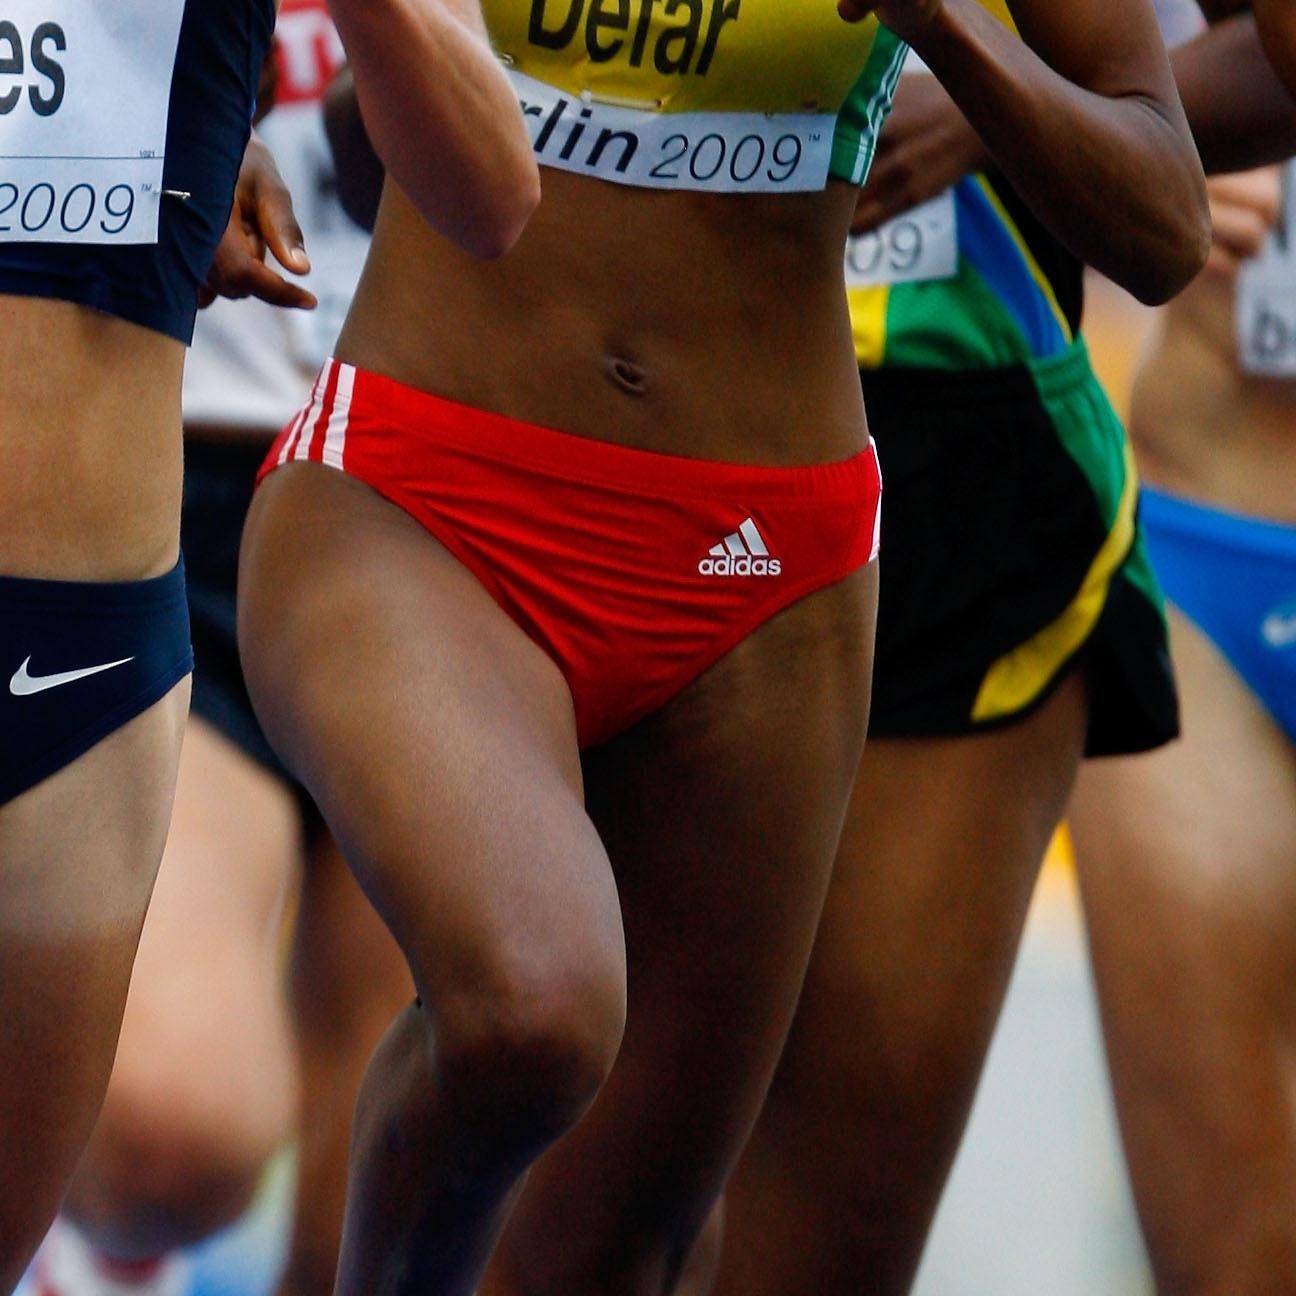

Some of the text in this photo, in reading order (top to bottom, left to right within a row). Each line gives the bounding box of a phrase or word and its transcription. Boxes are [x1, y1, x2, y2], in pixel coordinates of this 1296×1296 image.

[649, 133, 803, 183] 2009
[847, 221, 923, 273] 09
[698, 554, 782, 576] adidas
